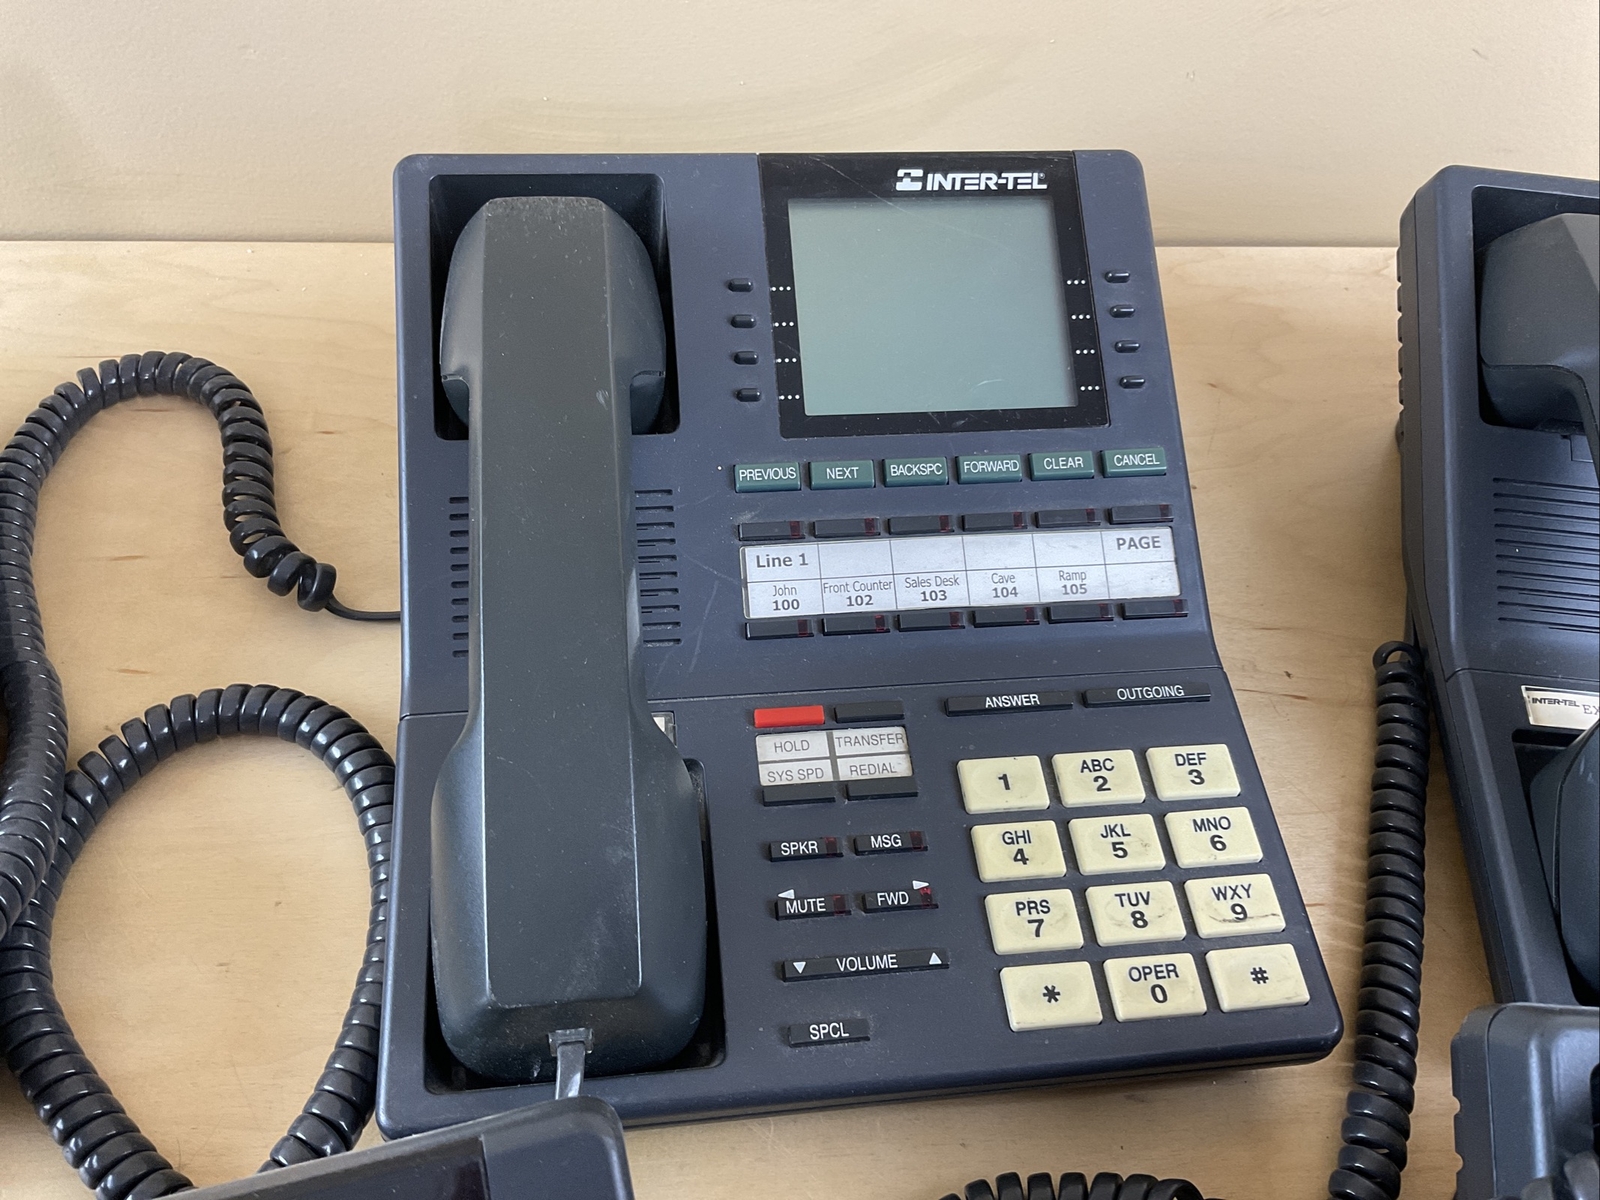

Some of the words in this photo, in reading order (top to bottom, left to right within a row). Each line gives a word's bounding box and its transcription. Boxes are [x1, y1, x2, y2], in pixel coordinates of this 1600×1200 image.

[964, 460, 1020, 474] FORWARD
[1043, 456, 1084, 470] CLEAR
[1113, 452, 1160, 467] CANCEL
[739, 467, 797, 481] PREVIOUS
[826, 467, 859, 480] NEXT
[890, 463, 943, 477] BACKSPC
[1116, 536, 1161, 550] PAGE
[756, 554, 793, 568] Line
[799, 553, 809, 566] 1
[905, 576, 931, 588] Sales
[935, 574, 959, 587] Desk
[991, 573, 1015, 584] Cave
[1059, 570, 1087, 582] Ramp
[772, 585, 797, 597] John
[823, 582, 850, 594] Front
[853, 580, 893, 592] Counter
[992, 587, 1018, 598] 104
[1061, 584, 1087, 595] 105
[846, 595, 874, 607] 102
[920, 590, 947, 602] 103
[772, 599, 800, 611] 100
[1117, 685, 1185, 701] OUTGOING
[985, 693, 1040, 709] ANSWER
[1532, 697, 1580, 707] INTER-TEL
[774, 740, 810, 753] HOLD
[835, 733, 905, 747] TRANSFER
[1080, 758, 1115, 774] ABC
[1175, 752, 1207, 767] DEF
[767, 770, 793, 783] SYS
[797, 768, 824, 780] SPD
[850, 762, 897, 776] REDIAL
[998, 774, 1011, 791] 1
[1093, 775, 1111, 792] 2
[1188, 769, 1206, 786] 3
[1100, 823, 1131, 839] JKL
[1193, 816, 1232, 832] MNO
[870, 834, 902, 848] MSG
[1002, 830, 1032, 846] GHI
[1210, 834, 1227, 852] 6
[781, 841, 819, 855] SPKR
[1112, 842, 1129, 859] 5
[1013, 848, 1029, 866] 4
[877, 891, 909, 906] FWD
[1115, 891, 1151, 908] TUV
[1212, 883, 1253, 901] WXY
[786, 898, 826, 914] MUTE
[1015, 900, 1051, 916] PRS
[1231, 903, 1248, 922] 9
[1131, 911, 1149, 929] 8
[1027, 918, 1044, 938] 7
[836, 954, 898, 972] VOLUME
[1128, 964, 1179, 982] OPER
[1150, 984, 1168, 1004] 0
[809, 1022, 850, 1040] SPCL
